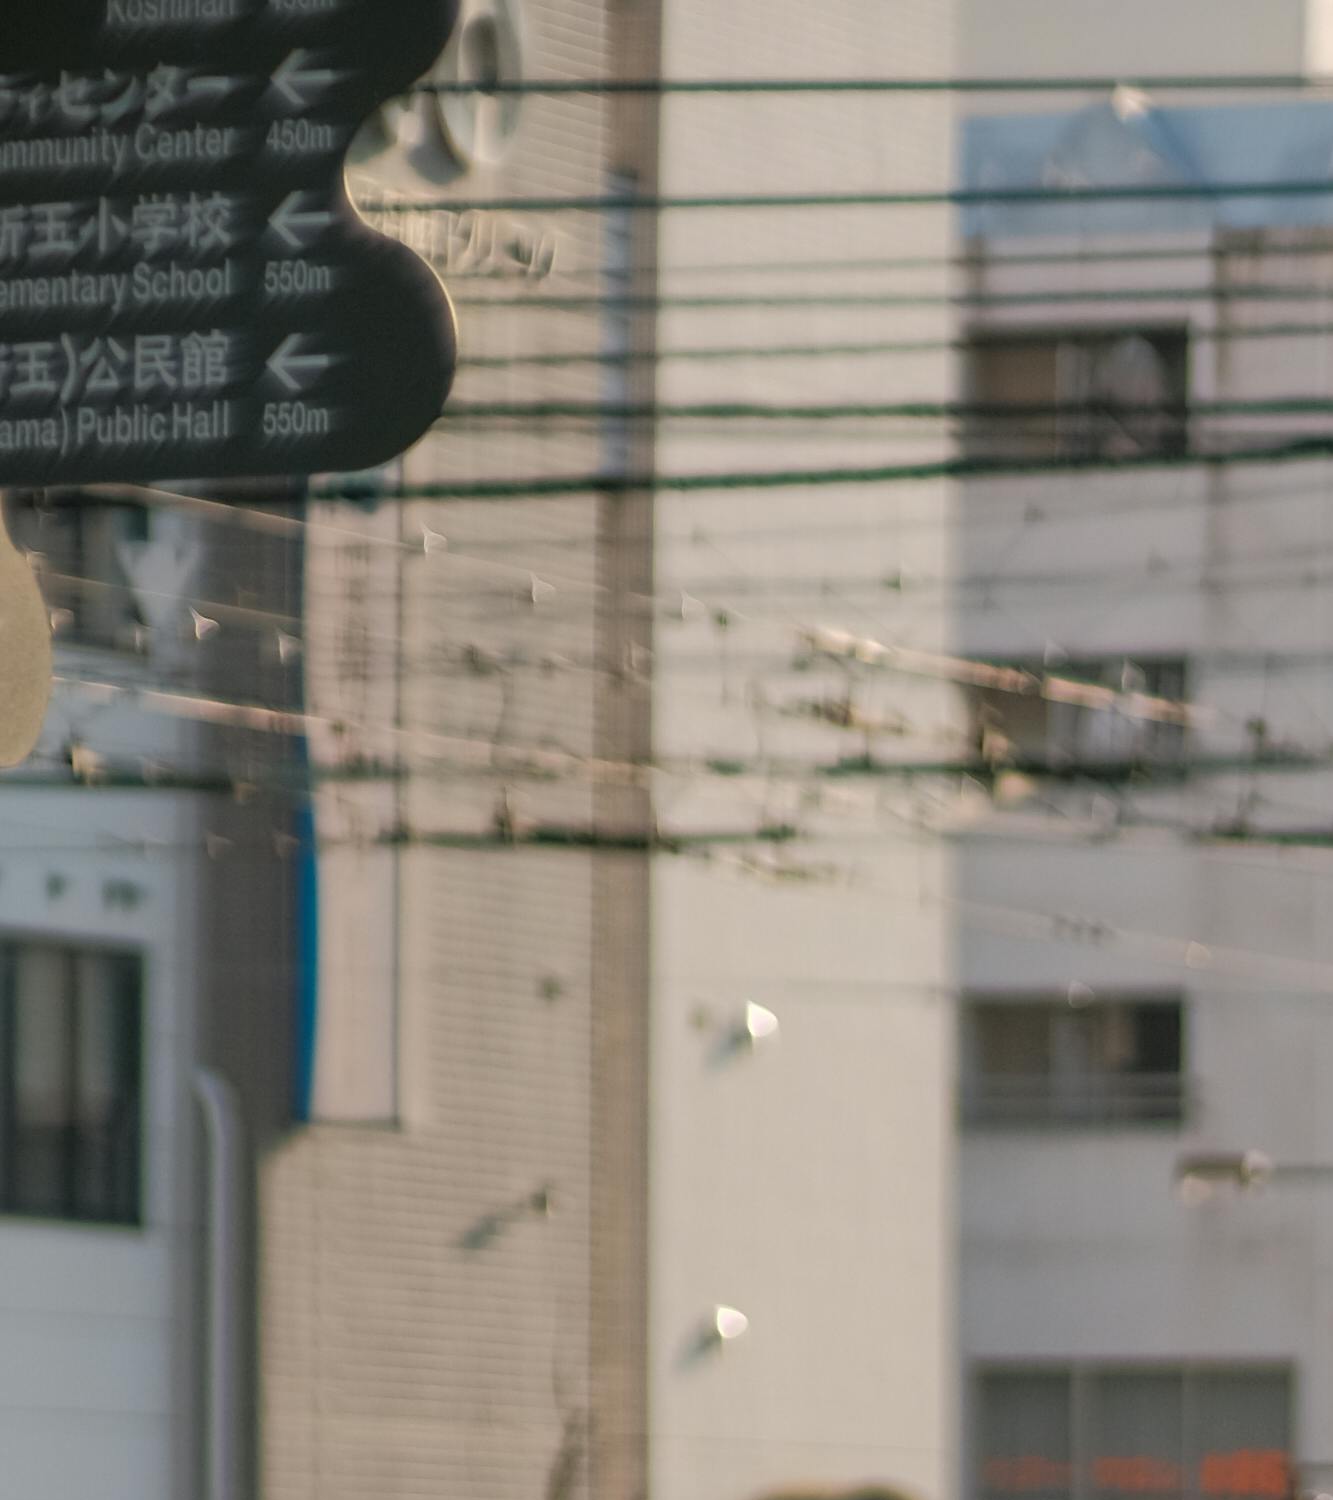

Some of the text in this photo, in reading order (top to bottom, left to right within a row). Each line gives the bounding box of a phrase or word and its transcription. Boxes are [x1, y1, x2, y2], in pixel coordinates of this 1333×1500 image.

[134, 122, 234, 160] Center
[265, 119, 333, 152] 450m
[132, 257, 232, 301] School
[264, 259, 331, 293] 550m
[0, 329, 228, 405] 玉)公民館
[0, 401, 329, 455] ama) Public Hall 550m
